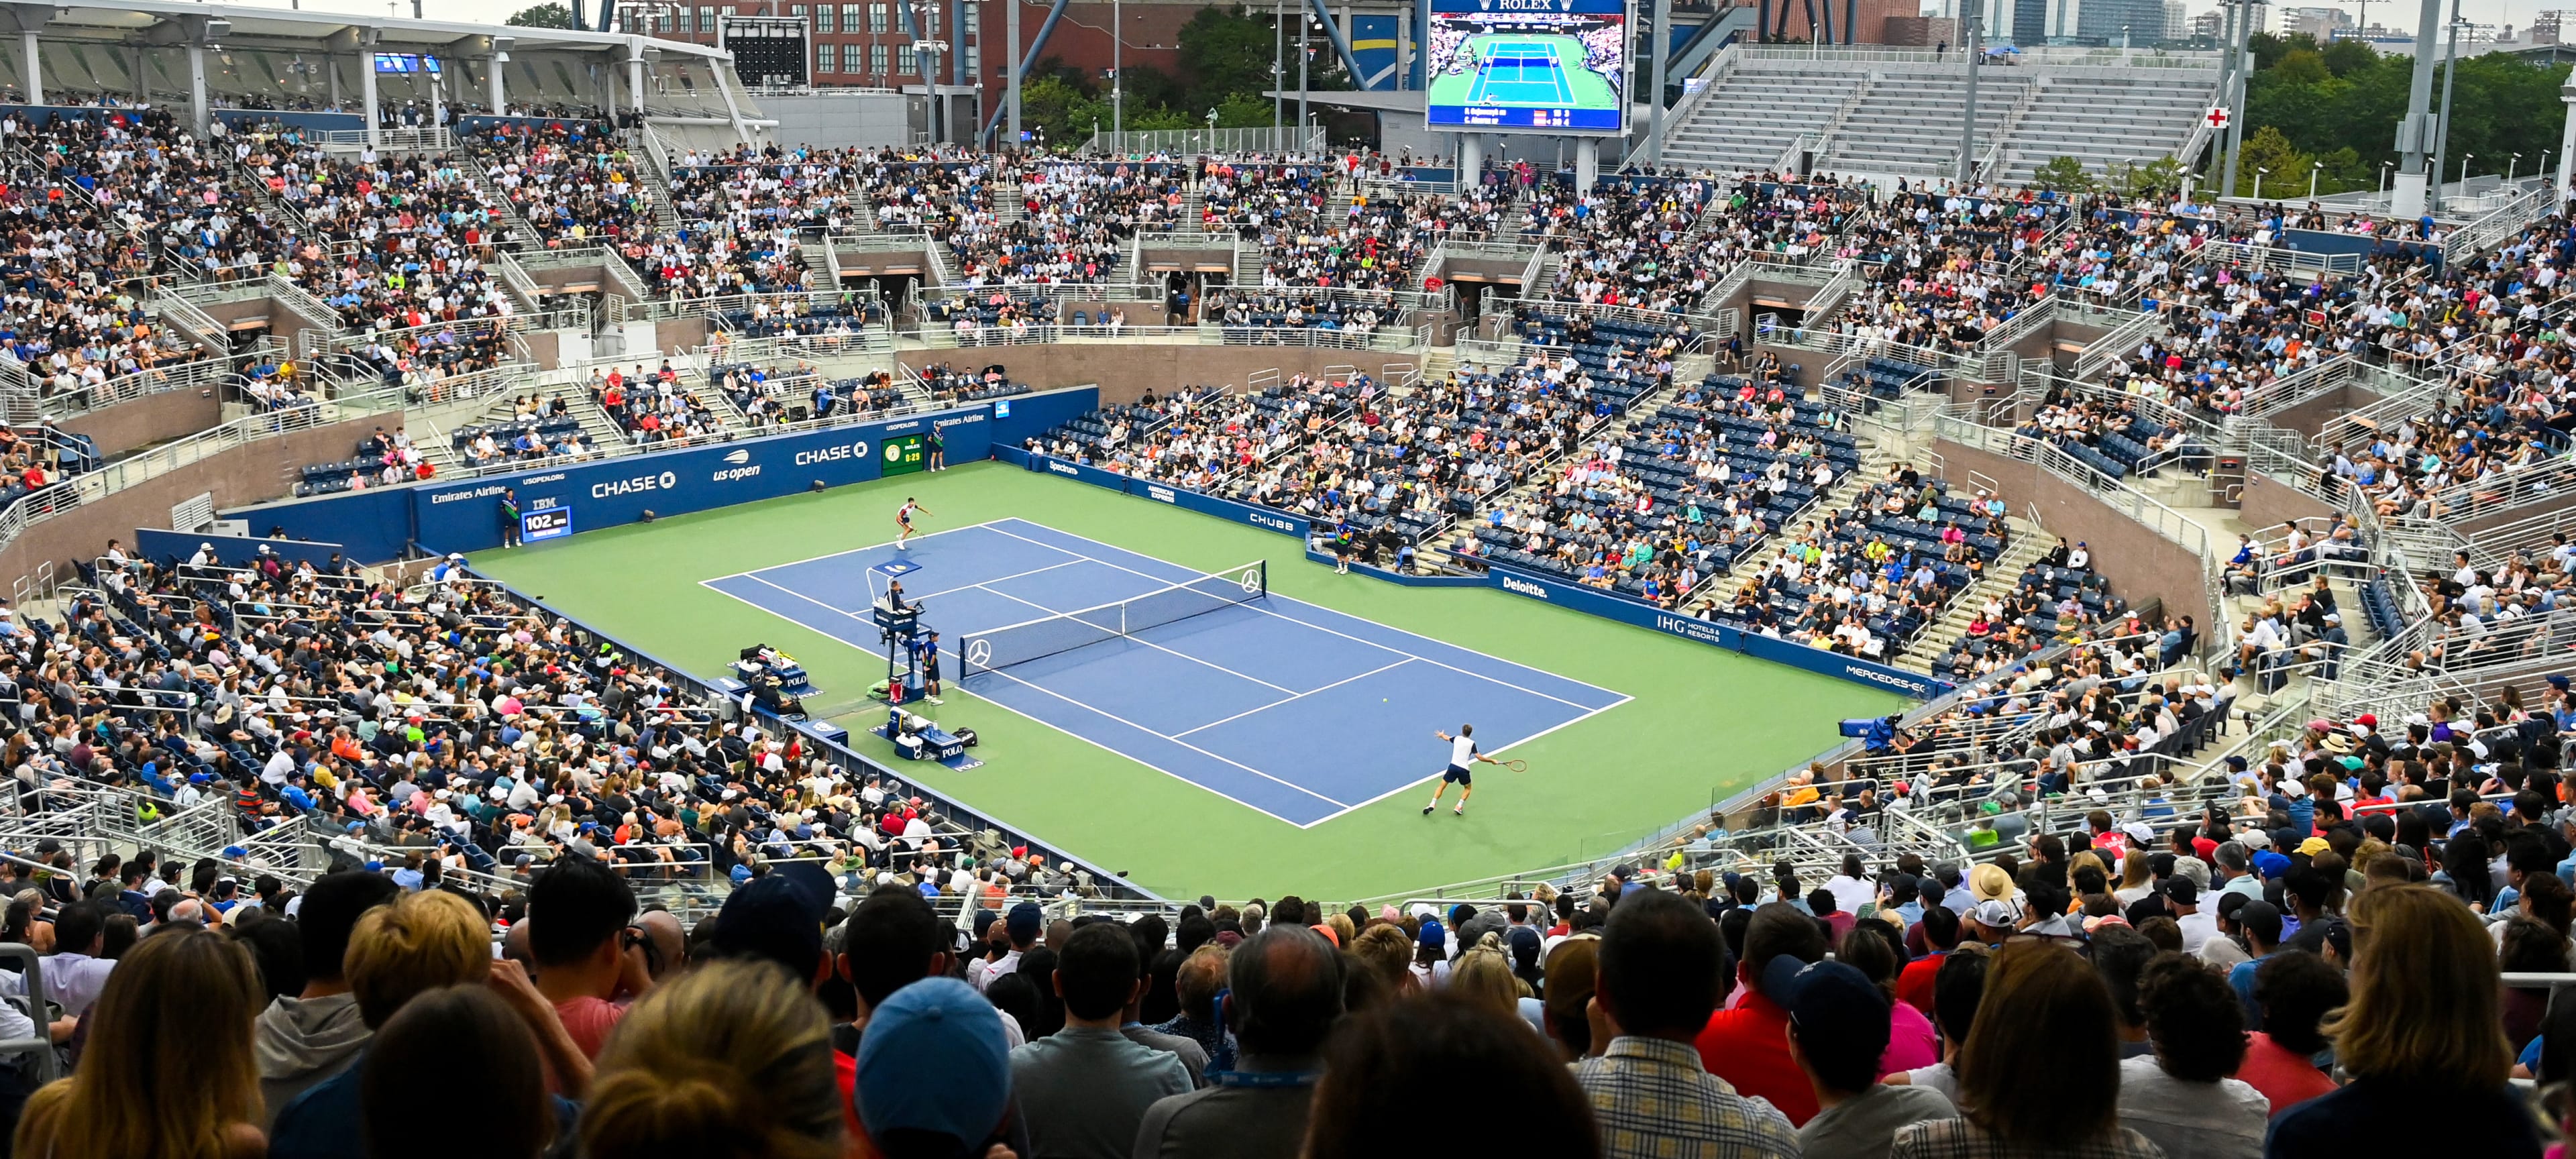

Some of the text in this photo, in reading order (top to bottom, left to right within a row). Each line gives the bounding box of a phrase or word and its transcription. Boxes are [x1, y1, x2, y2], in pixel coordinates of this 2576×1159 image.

[1499, 0, 1552, 9] ROLEX
[1309, 52, 1314, 61] 7
[310, 64, 317, 74] 5
[963, 414, 985, 423] Airline
[886, 421, 918, 431] USOPEN.ORG
[795, 445, 851, 465] CHASE
[906, 452, 920, 462] 0:29
[713, 465, 760, 482] us open
[1049, 461, 1076, 475] Spectrum
[523, 474, 565, 485] USOPEN.ORG
[592, 476, 656, 498] CHASE
[1148, 485, 1175, 497] AMERICAN
[431, 486, 506, 504] Emirates Airline
[1151, 492, 1175, 503] EXPRESS
[533, 497, 557, 510] IBM
[526, 514, 551, 530] 102
[1250, 513, 1293, 531] CHUBB
[1503, 576, 1548, 598] Deloitte.
[1658, 614, 1686, 633] IHG
[1688, 622, 1714, 634] HOTELS
[1687, 629, 1719, 642] RESORTS
[787, 675, 806, 687] POLO
[943, 744, 963, 758] POLO
